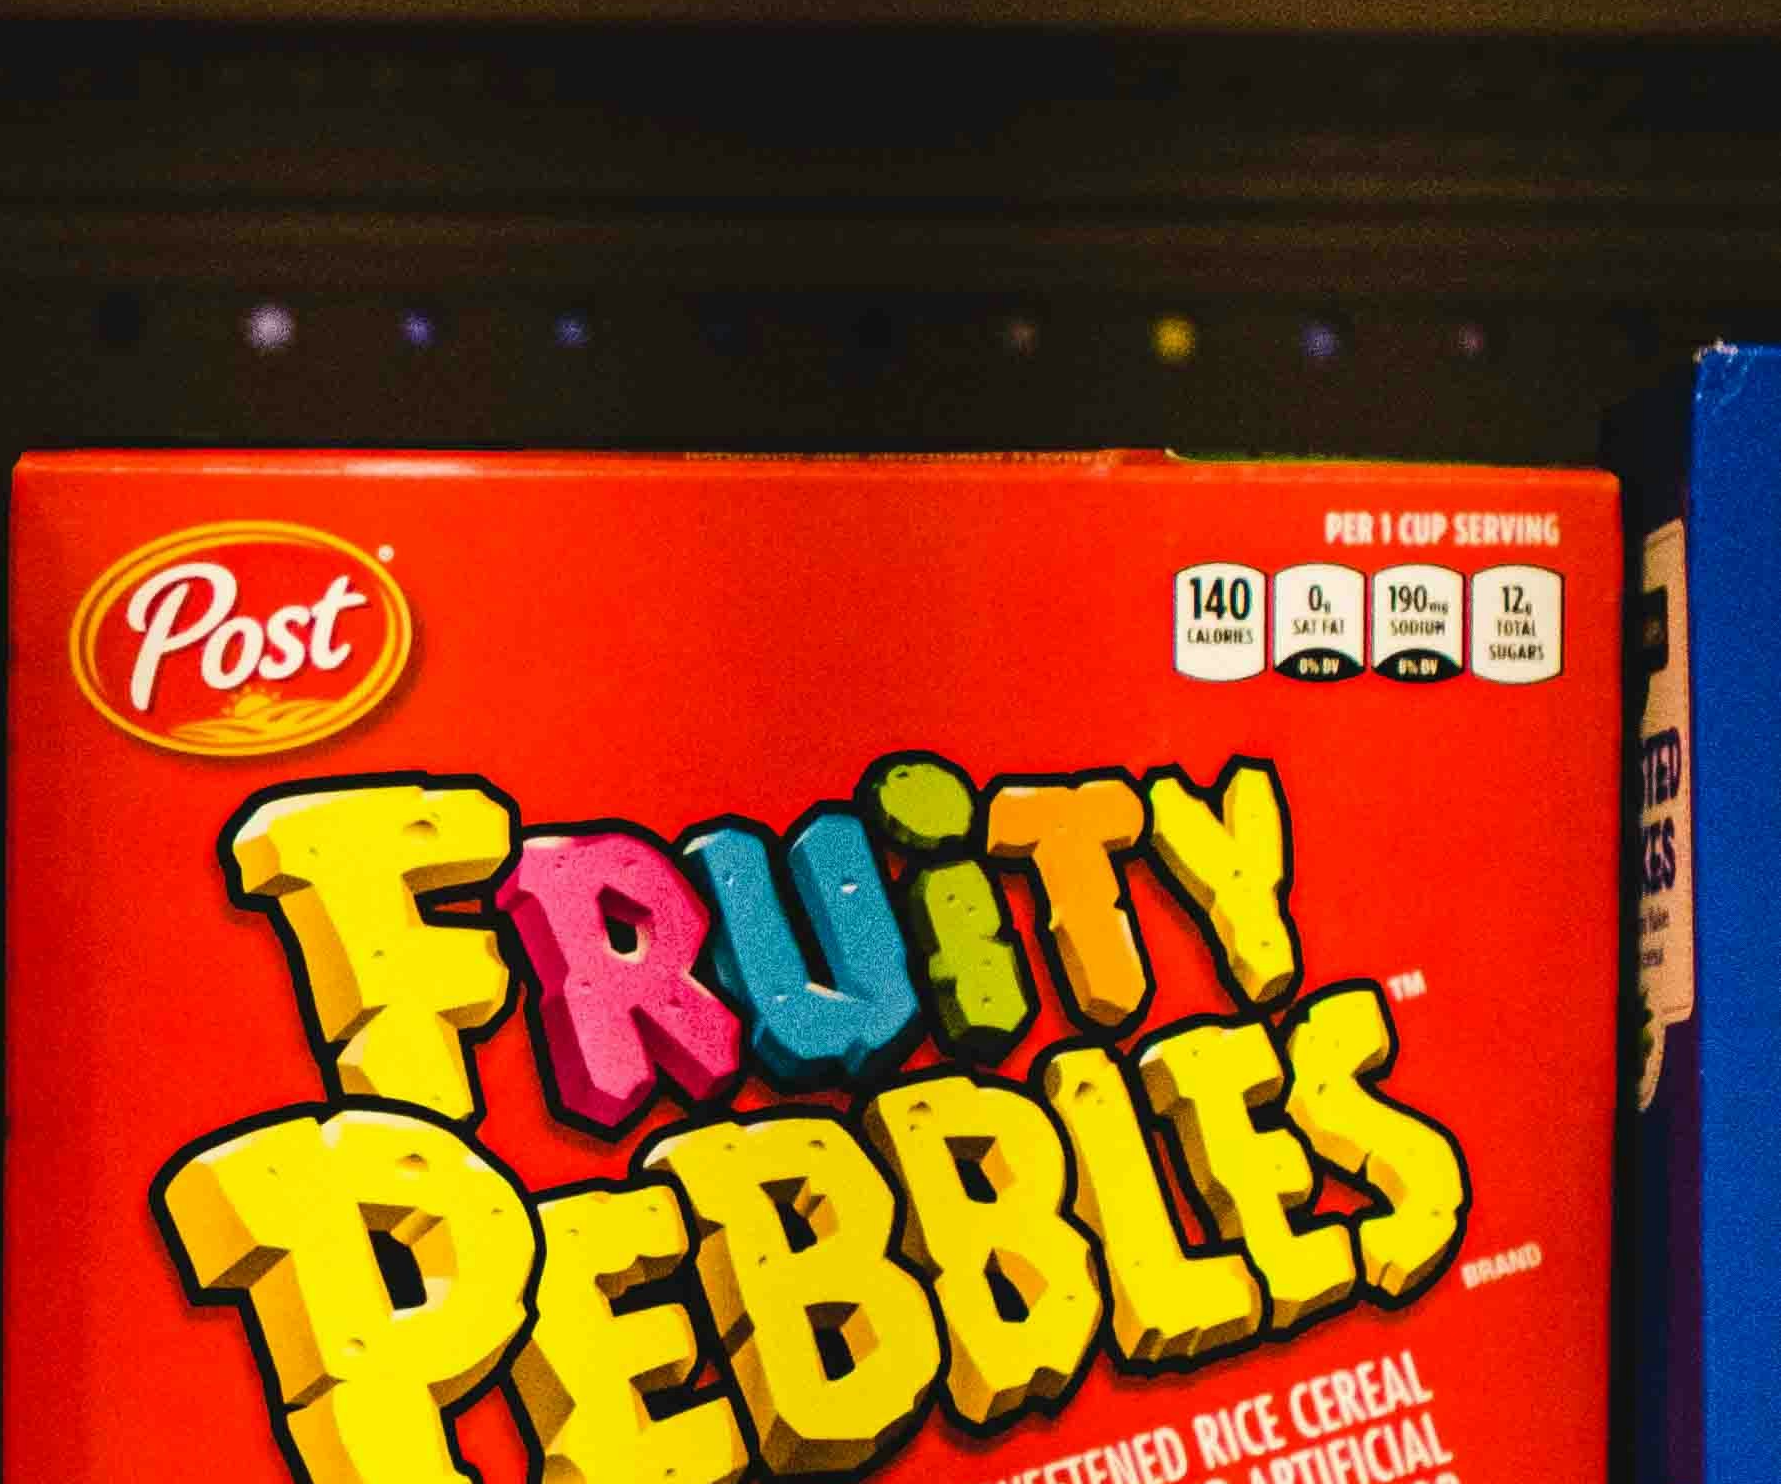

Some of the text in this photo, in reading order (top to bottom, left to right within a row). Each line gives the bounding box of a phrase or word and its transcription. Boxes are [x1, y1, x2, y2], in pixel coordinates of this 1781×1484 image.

[1325, 512, 1560, 547] PER 1 CUP SERVING
[1189, 577, 1252, 621] 140
[126, 561, 368, 712] Post
[1187, 627, 1253, 645] CALORIES
[1292, 619, 1345, 636] SAT FAT
[1390, 619, 1446, 636] SODIUM
[1497, 619, 1537, 637] TOTAL
[1488, 643, 1545, 661] SUGARS
[1461, 1242, 1541, 1292] BRAND
[1193, 1394, 1287, 1470] RICE
[1288, 1350, 1433, 1434] CEREAL
